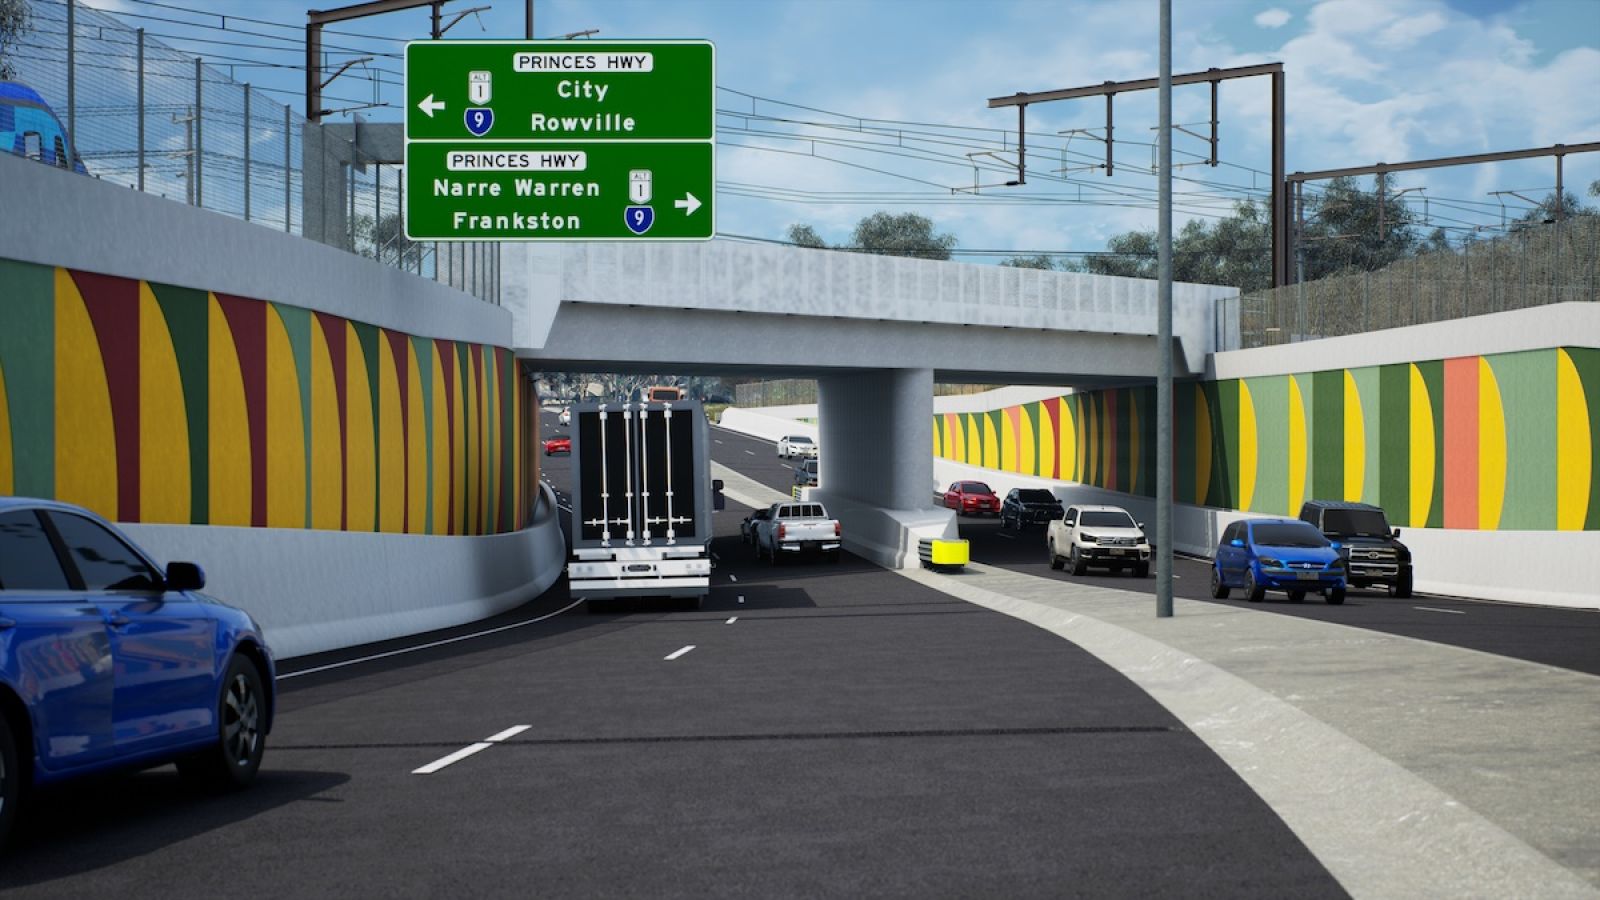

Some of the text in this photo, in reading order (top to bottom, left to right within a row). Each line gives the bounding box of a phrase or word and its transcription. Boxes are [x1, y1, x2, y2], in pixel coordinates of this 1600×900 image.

[519, 56, 646, 69] PRINCES HWY
[473, 73, 487, 81] ALT
[557, 80, 609, 102] City
[473, 111, 485, 127] 9
[531, 113, 636, 131] Rowville
[452, 154, 579, 168] PRINCES HWY
[433, 179, 600, 197] Narre Warren
[453, 212, 580, 230] Frankston
[634, 210, 645, 226] 9
